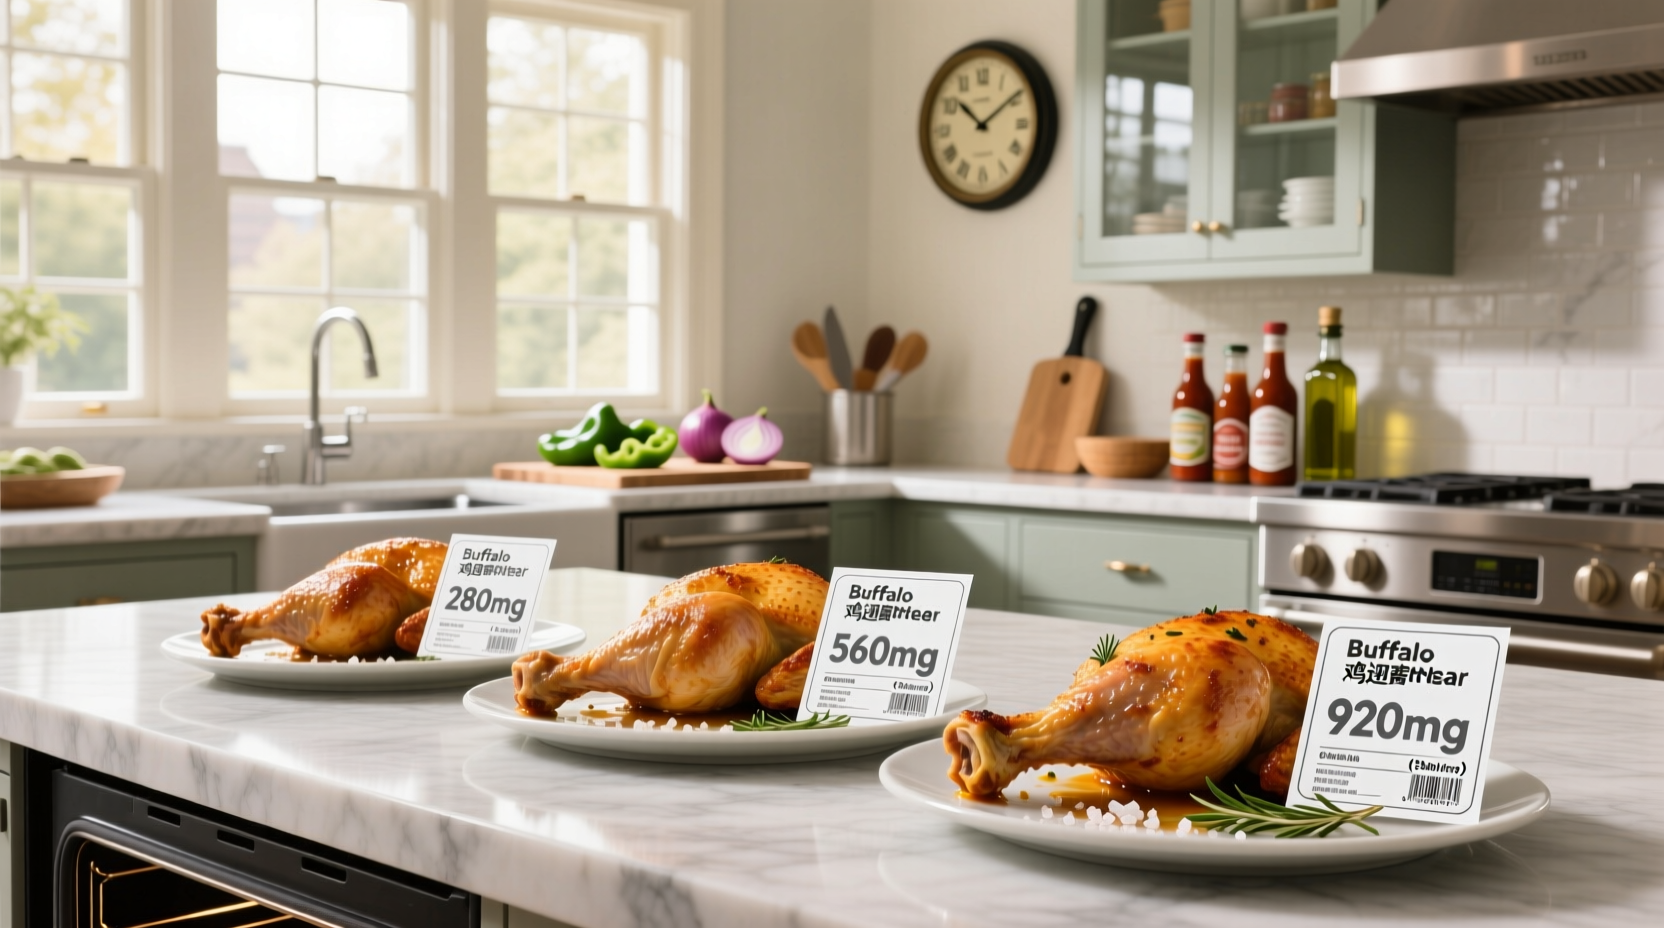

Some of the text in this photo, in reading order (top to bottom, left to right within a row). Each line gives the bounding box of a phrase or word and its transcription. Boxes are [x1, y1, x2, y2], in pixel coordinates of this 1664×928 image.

[462, 548, 511, 562] Buffalo
[444, 585, 527, 623] 280mg
[848, 584, 914, 603] Buffalo
[828, 632, 939, 677] 560mg
[1346, 638, 1435, 663] Buffalo
[1327, 697, 1470, 755] 920mg
